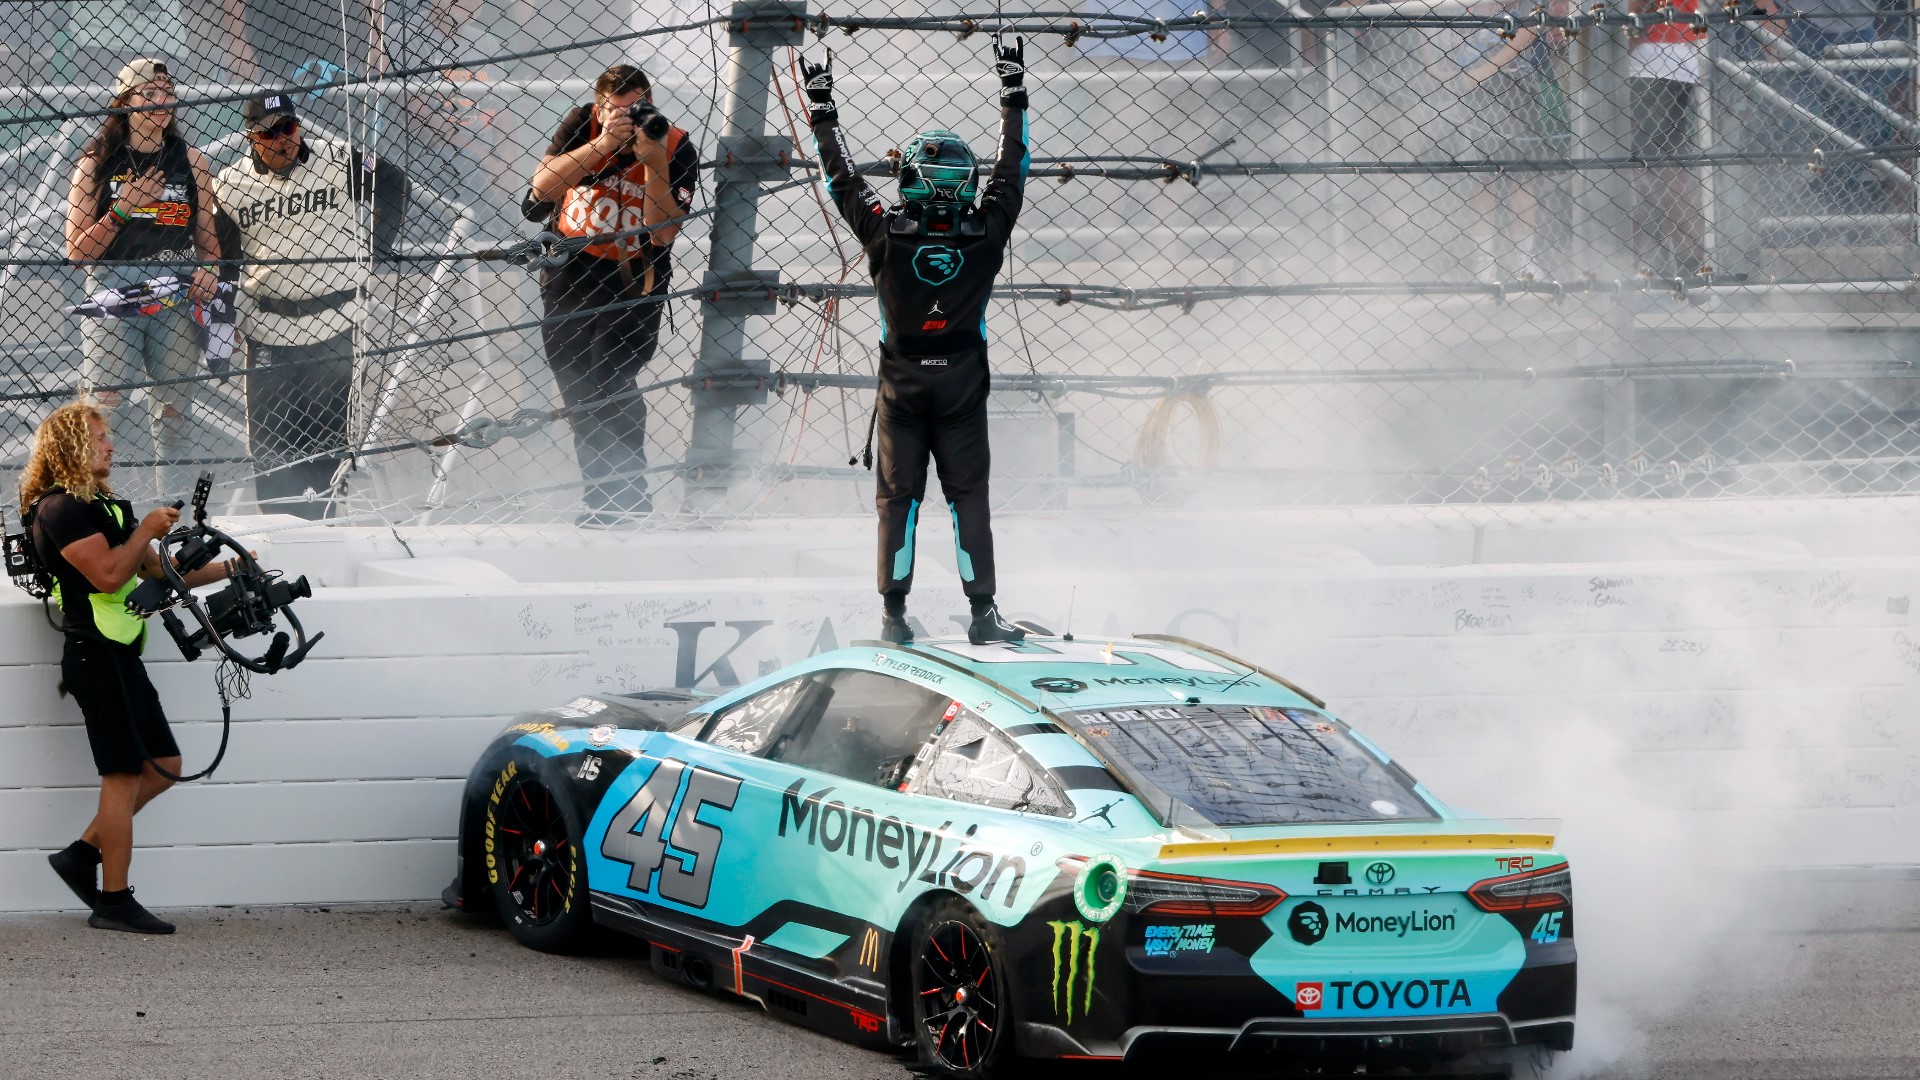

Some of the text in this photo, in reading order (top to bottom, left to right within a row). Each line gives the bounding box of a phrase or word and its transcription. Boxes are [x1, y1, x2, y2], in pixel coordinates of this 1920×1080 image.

[832, 126, 856, 178] MoneyLion
[155, 202, 191, 227] 22
[238, 187, 339, 229] OFFICIAL
[882, 658, 910, 673] TYLER
[910, 665, 947, 685] REDDICK
[1092, 676, 1262, 688] MoneyLion
[600, 756, 745, 910] 45
[777, 776, 1027, 910] MoneyLion
[1495, 855, 1534, 873] TRD
[1145, 924, 1216, 943] EVERY TIME
[1335, 909, 1455, 938] MoneyLion
[1530, 911, 1564, 944] 45
[1175, 937, 1216, 954] MONEY
[1330, 978, 1472, 1010] TOYOTA
[849, 1010, 880, 1033] TRD
